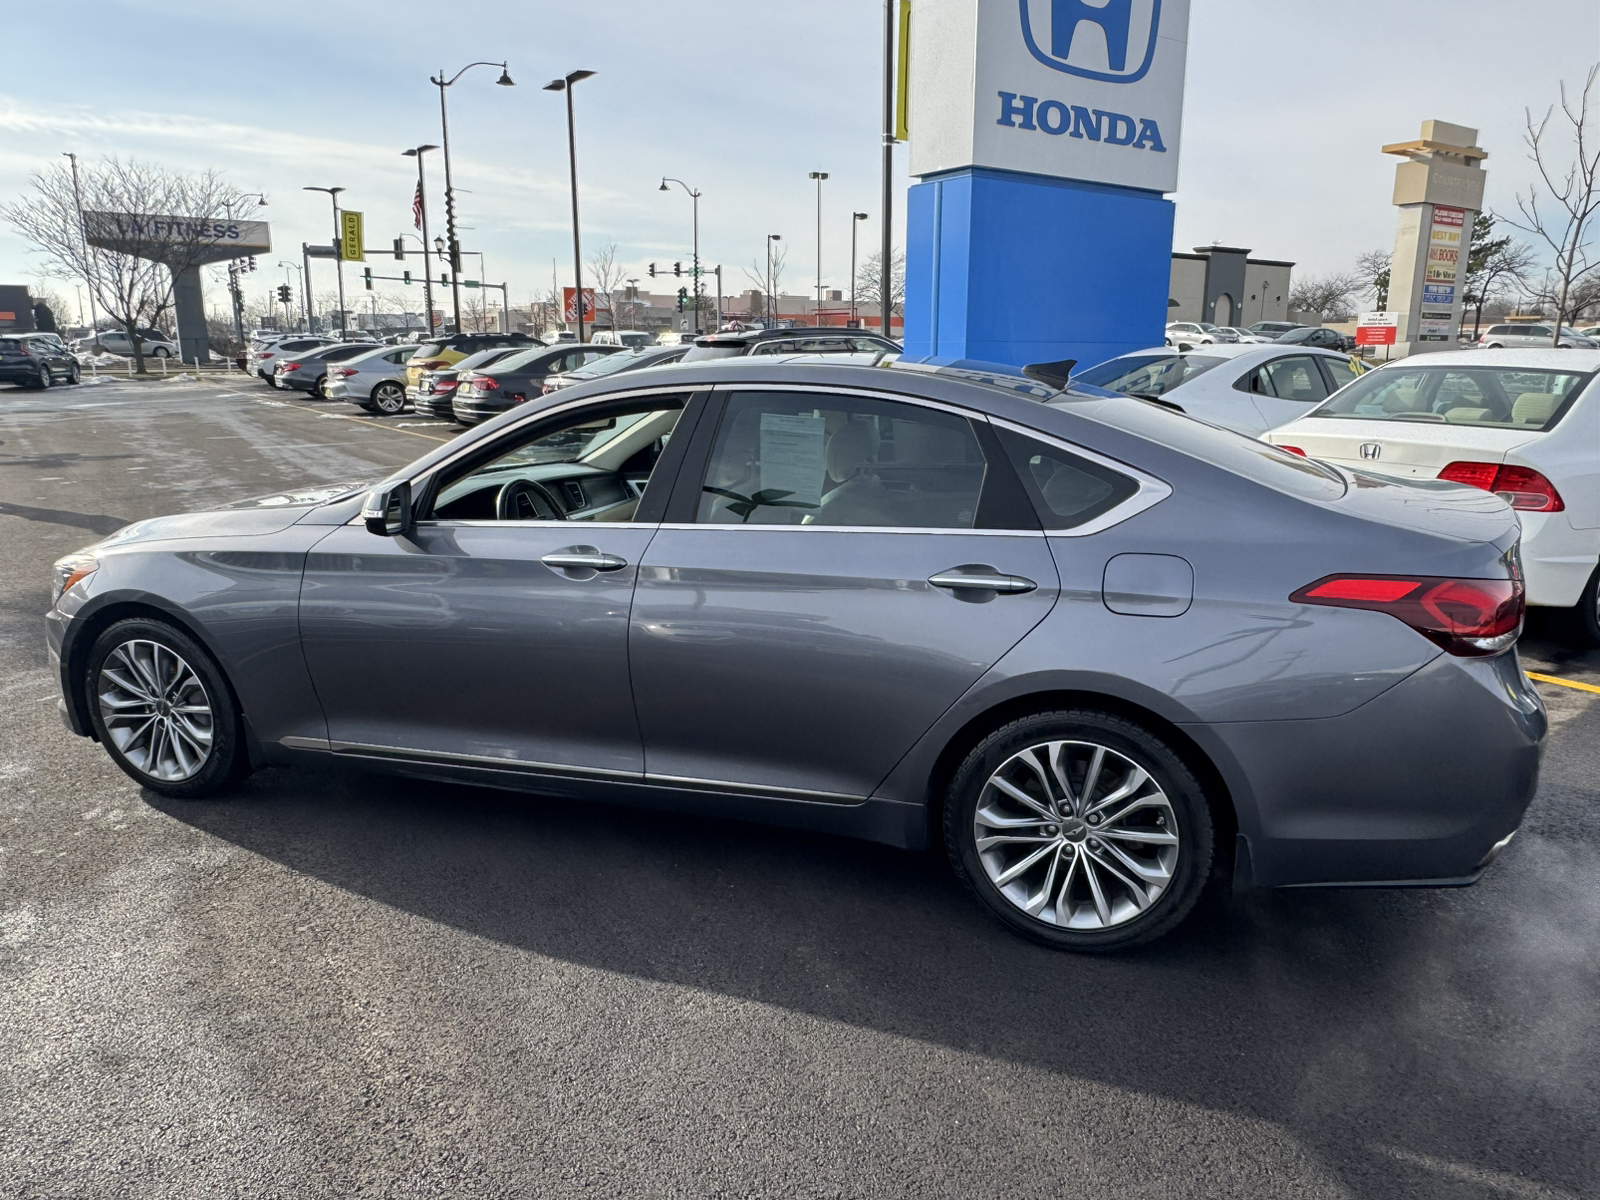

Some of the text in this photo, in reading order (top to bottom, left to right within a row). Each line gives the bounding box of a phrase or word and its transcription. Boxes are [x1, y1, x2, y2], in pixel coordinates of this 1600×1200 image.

[996, 90, 1167, 153] HONDA
[154, 220, 240, 240] FITNESS
[348, 217, 357, 255] GERALD
[1432, 230, 1460, 242] BEST BUY
[1438, 248, 1459, 265] BOOKS
